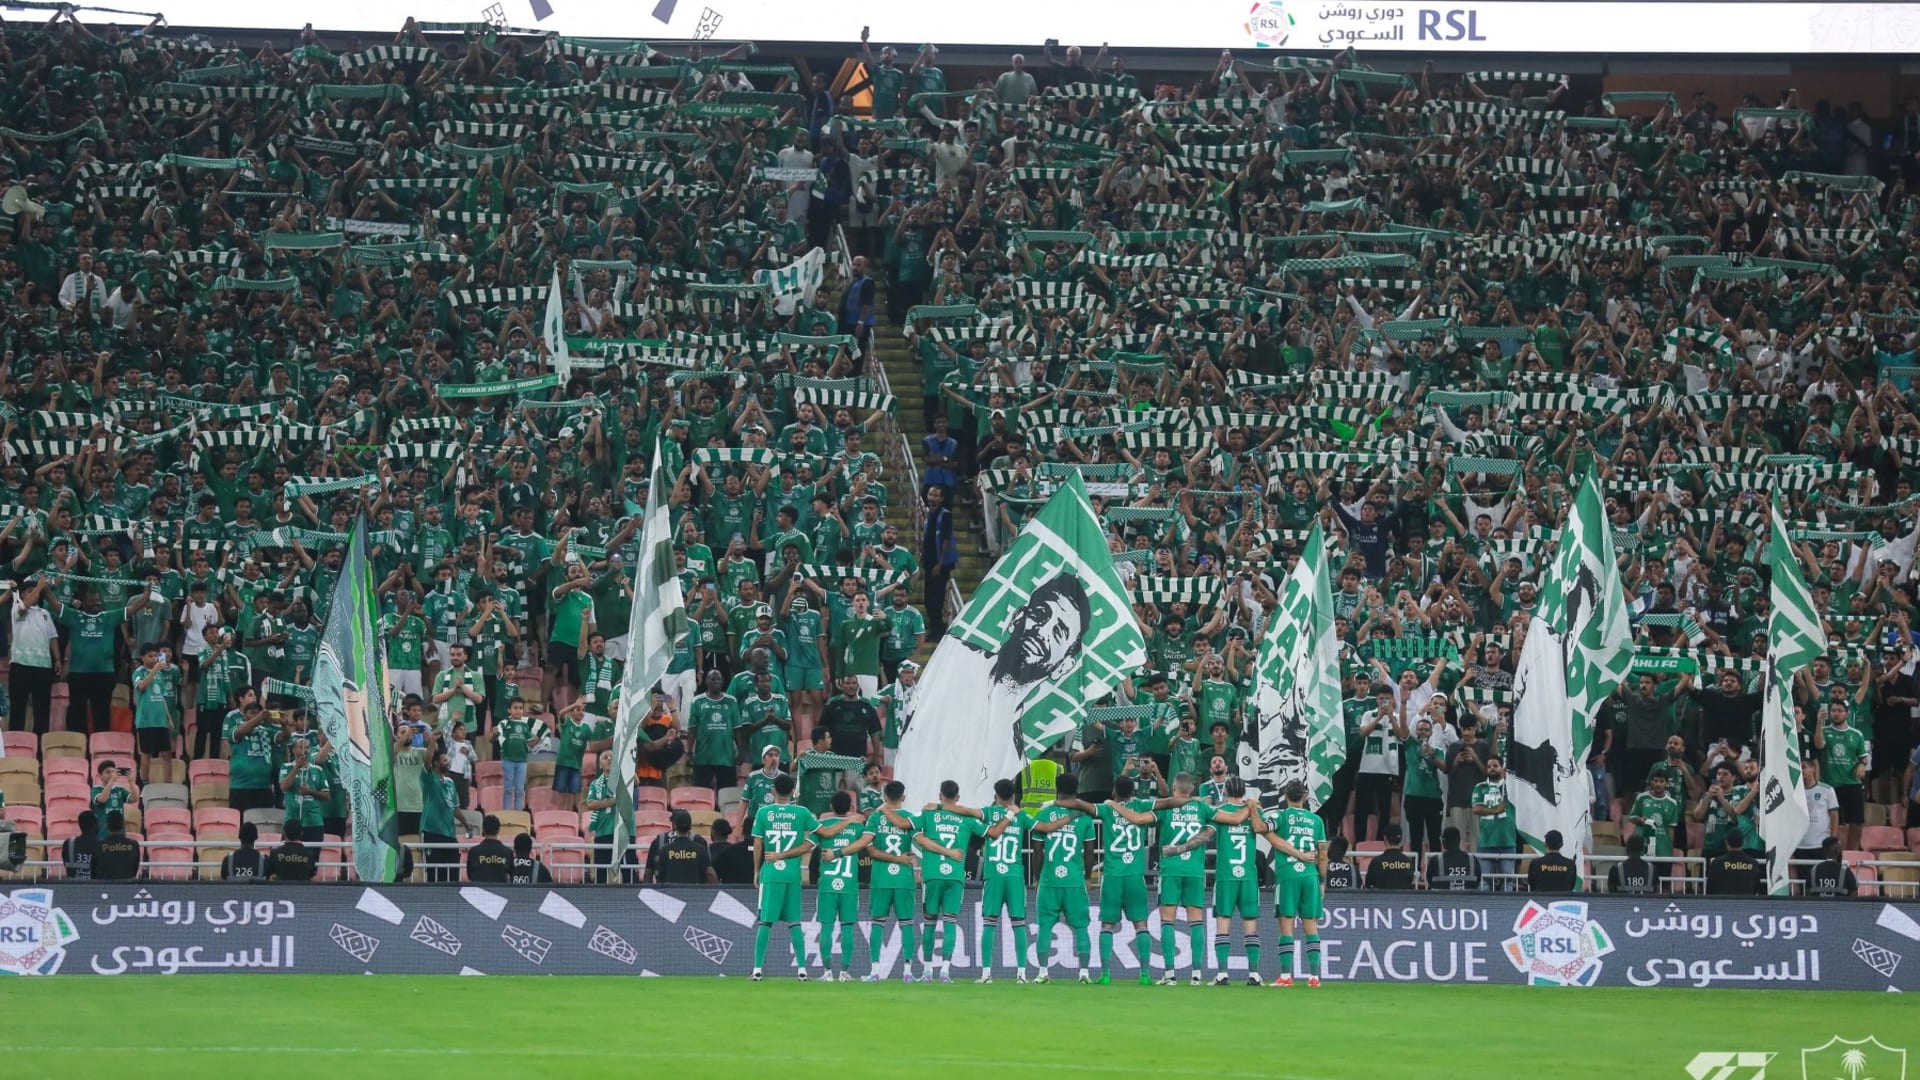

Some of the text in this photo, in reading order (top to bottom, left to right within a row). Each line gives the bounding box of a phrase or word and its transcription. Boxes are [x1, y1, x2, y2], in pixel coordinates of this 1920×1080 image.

[1318, 3, 1404, 24] دوري روشن
[1260, 19, 1280, 29] RSL
[1418, 9, 1487, 41] RSL
[1318, 25, 1404, 48] السعودي
[1661, 659, 1678, 668] FC
[1035, 779, 1051, 789] 159
[765, 830, 798, 854] 37
[885, 834, 902, 857] 8
[1109, 824, 1142, 853] 20
[102, 843, 133, 853] Police
[939, 833, 956, 861] 7
[1046, 832, 1078, 862] 79
[1229, 835, 1247, 865] 3
[278, 853, 309, 863] Police
[479, 854, 507, 865] Police
[668, 849, 697, 860] Police
[235, 867, 254, 877] 226
[1382, 861, 1411, 870] Police
[1448, 867, 1467, 877] 255
[1541, 864, 1568, 873] Police
[1724, 861, 1753, 871] Police
[1330, 877, 1348, 887] 662
[1626, 877, 1645, 887] 180
[1819, 878, 1836, 888] 190
[91, 887, 296, 934] دوري روشن
[1401, 907, 1488, 931] SAUDI
[1624, 901, 1819, 948] دوري روشن
[0, 925, 39, 943] RSL
[1540, 937, 1577, 954] RSL
[1293, 939, 1489, 982] LEAGUE
